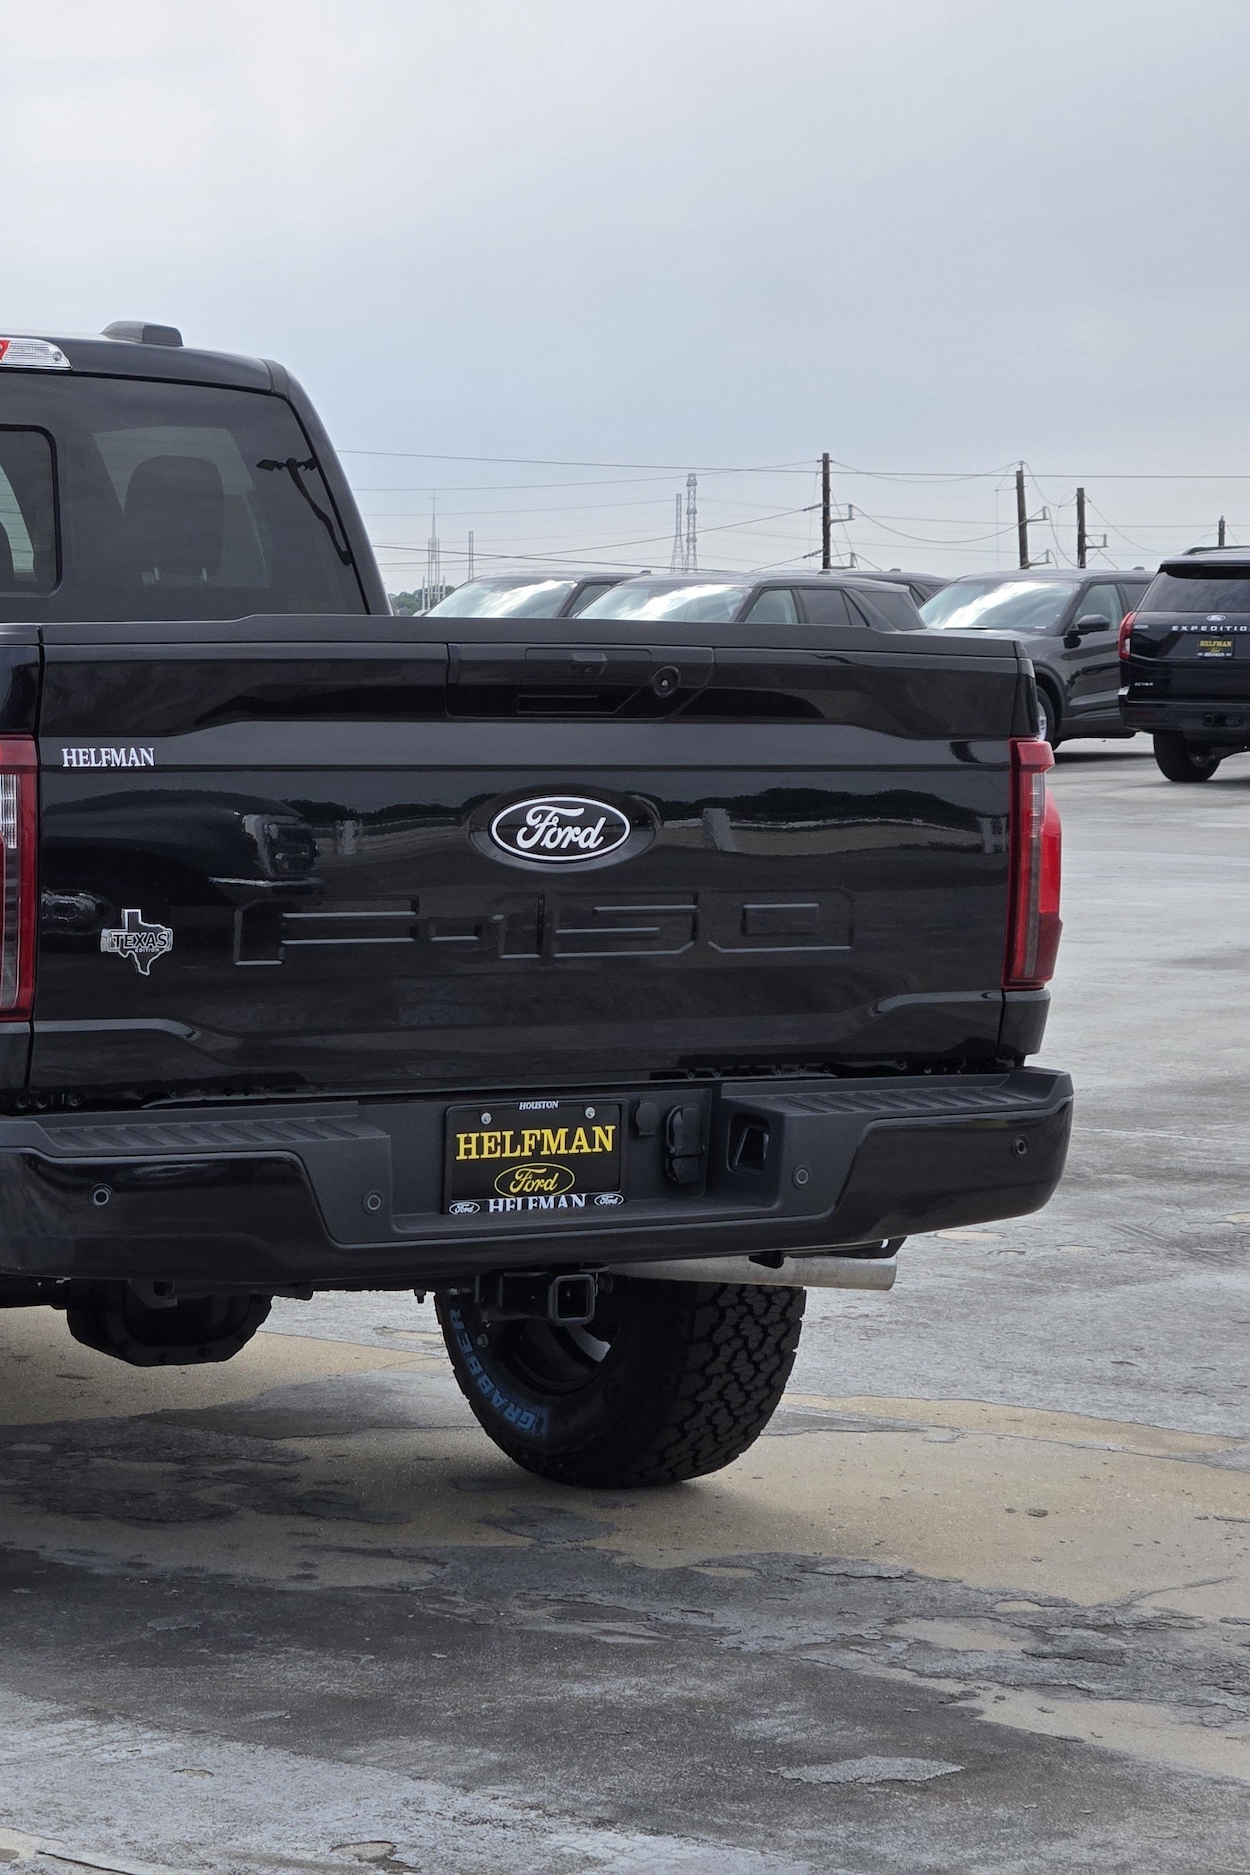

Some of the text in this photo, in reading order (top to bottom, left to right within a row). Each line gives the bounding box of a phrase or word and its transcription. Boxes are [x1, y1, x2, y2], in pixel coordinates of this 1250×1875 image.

[61, 748, 154, 767] HELFMAN
[516, 806, 606, 850] Ford
[234, 888, 853, 965] F-150
[112, 932, 169, 948] TEXAS
[518, 1101, 559, 1110] HOUSTON
[456, 1125, 616, 1160] HELFMAN
[510, 1168, 559, 1193] Ford
[489, 1194, 586, 1213] HELFMAN
[451, 1308, 536, 1430] GRABBER
